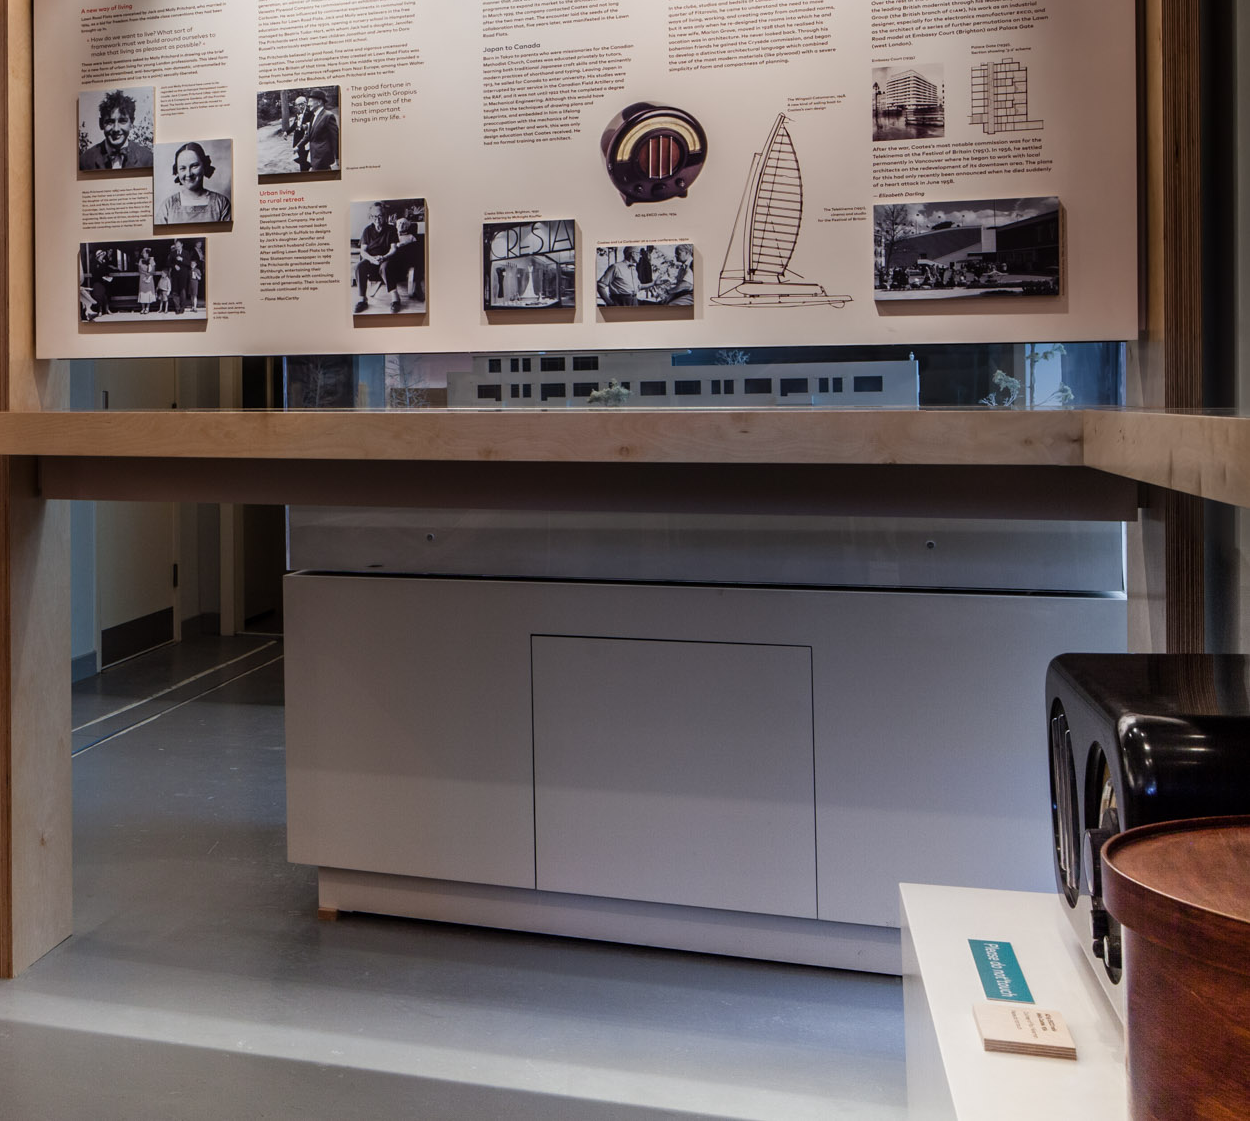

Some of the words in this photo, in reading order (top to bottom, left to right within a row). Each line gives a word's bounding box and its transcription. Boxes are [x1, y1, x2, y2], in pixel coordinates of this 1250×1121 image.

[118, 3, 132, 11] living
[984, 943, 1000, 960] Please
[993, 969, 1008, 979] not
[997, 979, 1017, 997] touch
